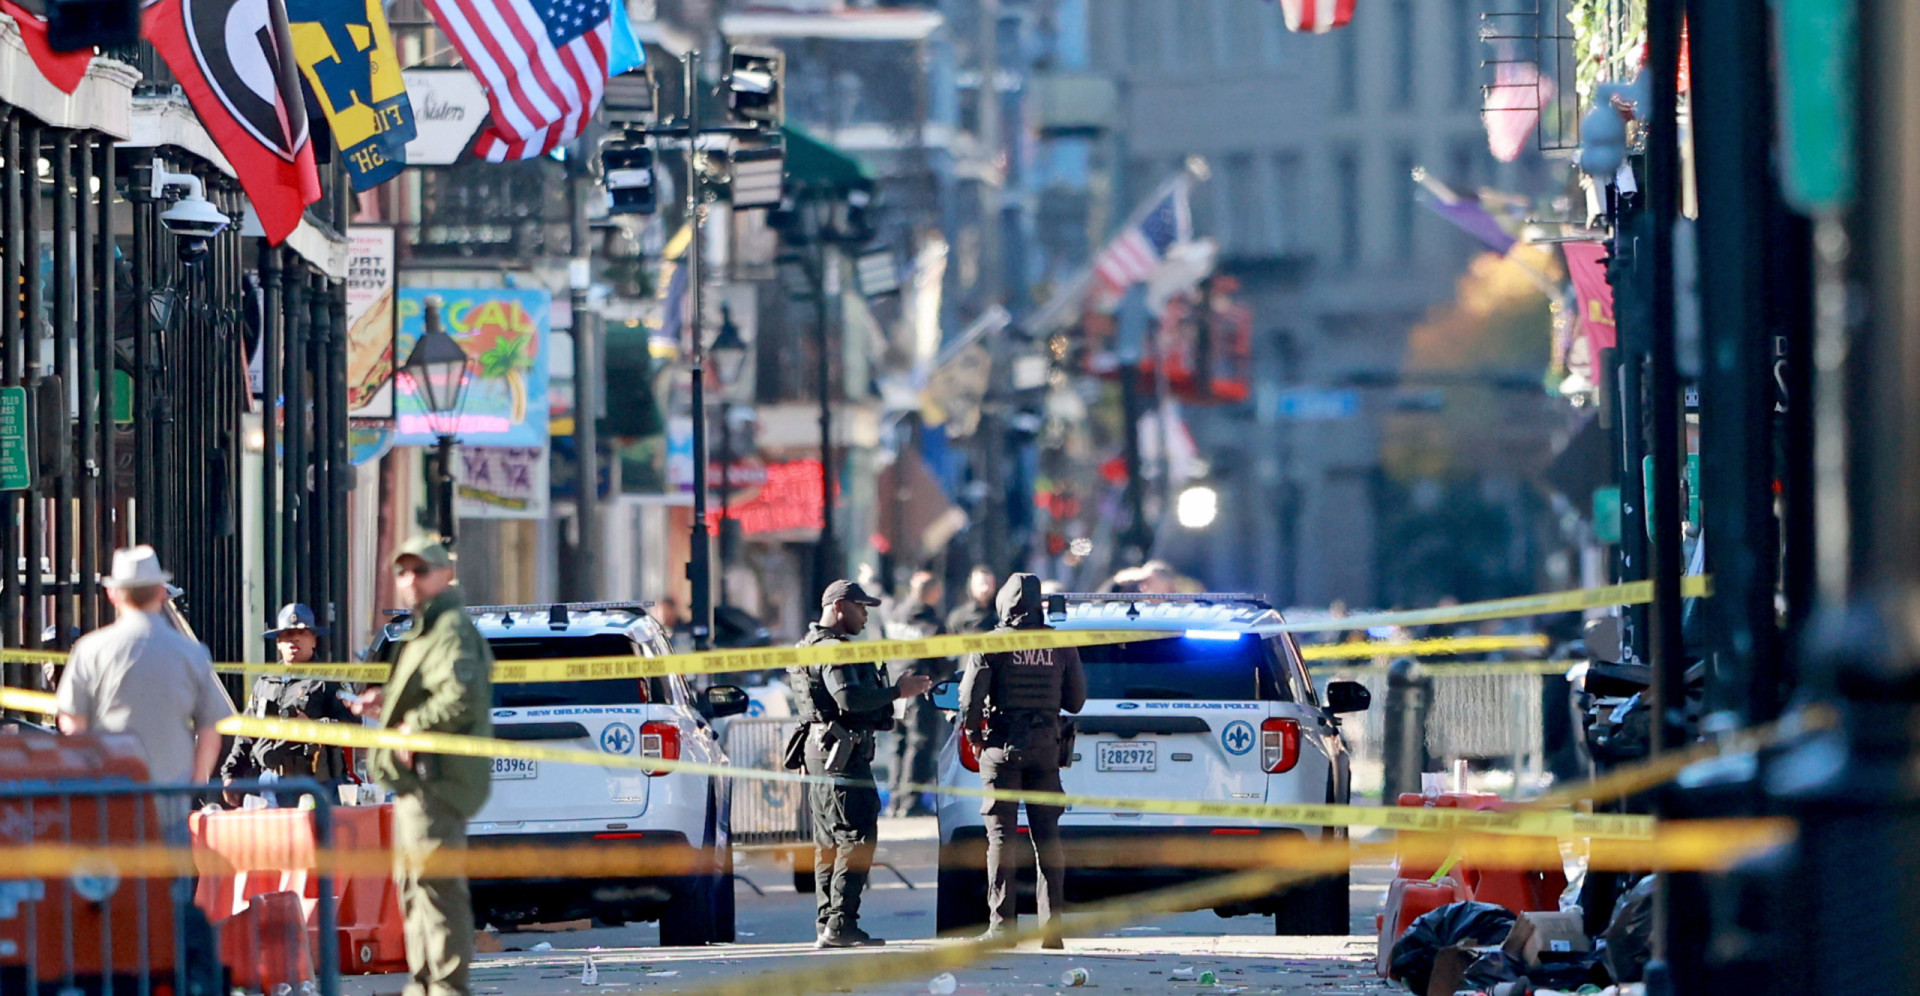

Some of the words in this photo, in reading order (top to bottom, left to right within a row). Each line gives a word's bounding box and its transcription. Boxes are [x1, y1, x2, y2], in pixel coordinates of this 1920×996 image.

[527, 709, 550, 717] NEW
[553, 708, 604, 716] ORLEANS
[1108, 749, 1154, 764] 282972
